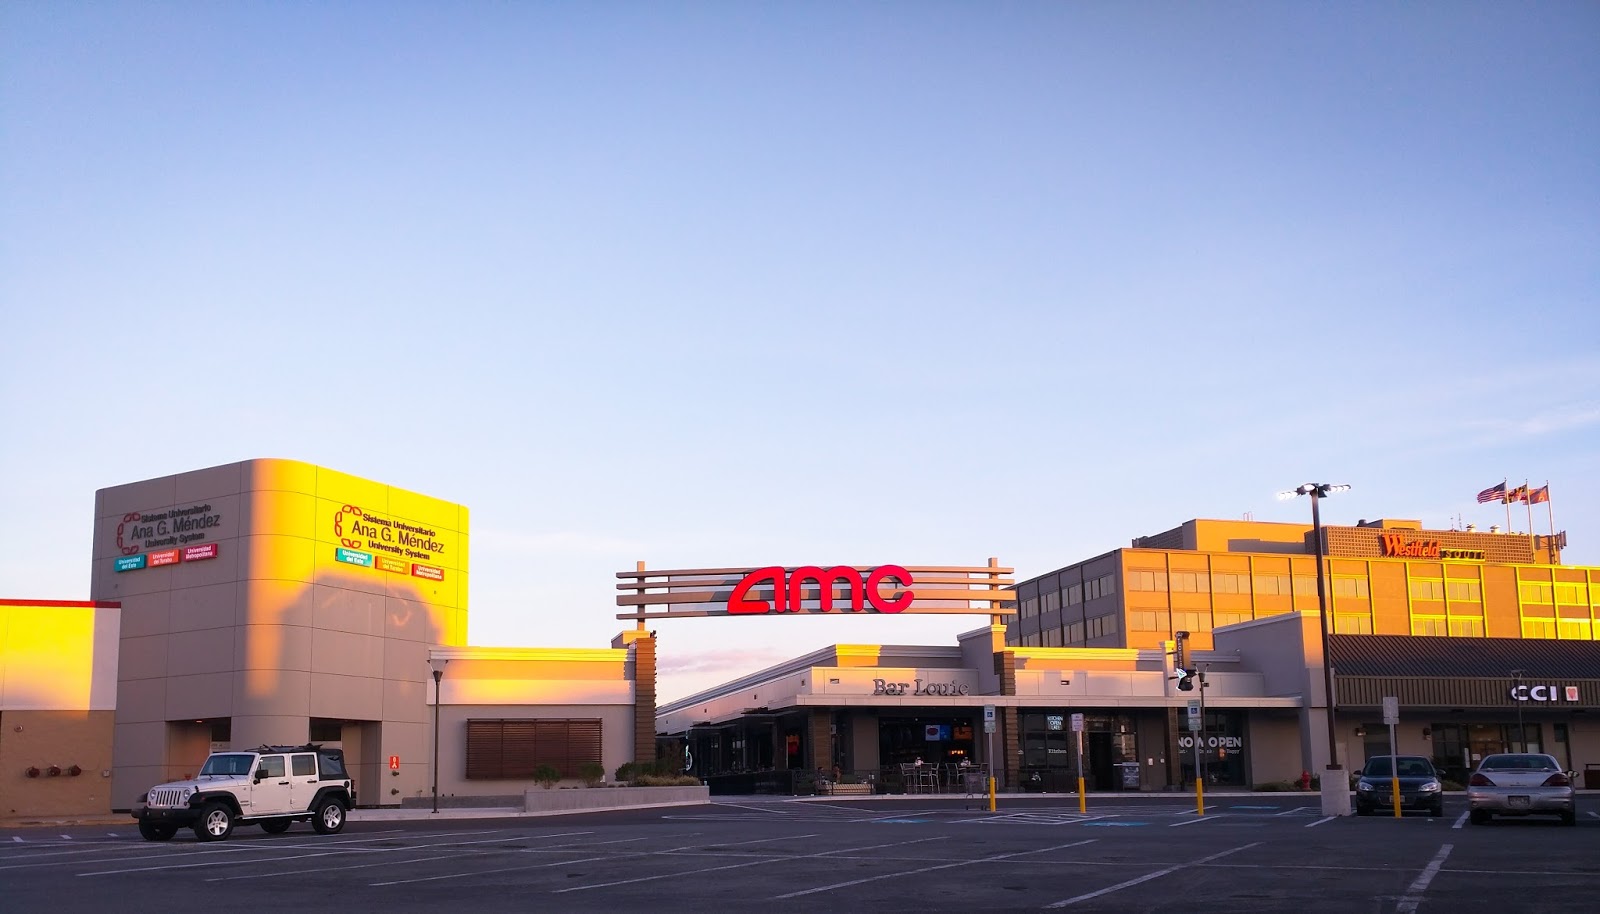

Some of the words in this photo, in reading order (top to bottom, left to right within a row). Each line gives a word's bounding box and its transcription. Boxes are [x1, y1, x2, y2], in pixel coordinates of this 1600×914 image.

[142, 512, 167, 523] Sistema
[169, 504, 211, 518] Universitario
[131, 525, 153, 540] Ana
[157, 521, 170, 535] G.
[173, 513, 220, 533] Méndez
[363, 513, 391, 527] Sistema
[393, 521, 435, 537] Universitario
[145, 535, 178, 548] University
[179, 532, 204, 544] System
[352, 520, 377, 539] Ana
[381, 527, 395, 543] G.
[398, 530, 444, 554] Méndez
[188, 545, 211, 554] Universidad
[368, 540, 404, 556] University
[405, 548, 430, 560] System
[1382, 534, 1441, 557] Westfield
[119, 557, 140, 565] Universidad
[153, 551, 174, 559] Universidad
[342, 550, 368, 560] Universidad
[382, 558, 405, 568] Universidad
[873, 679, 910, 695] Bar
[914, 679, 970, 696] Louie
[1511, 685, 1557, 701] CCI
[1208, 736, 1242, 748] OPEN
